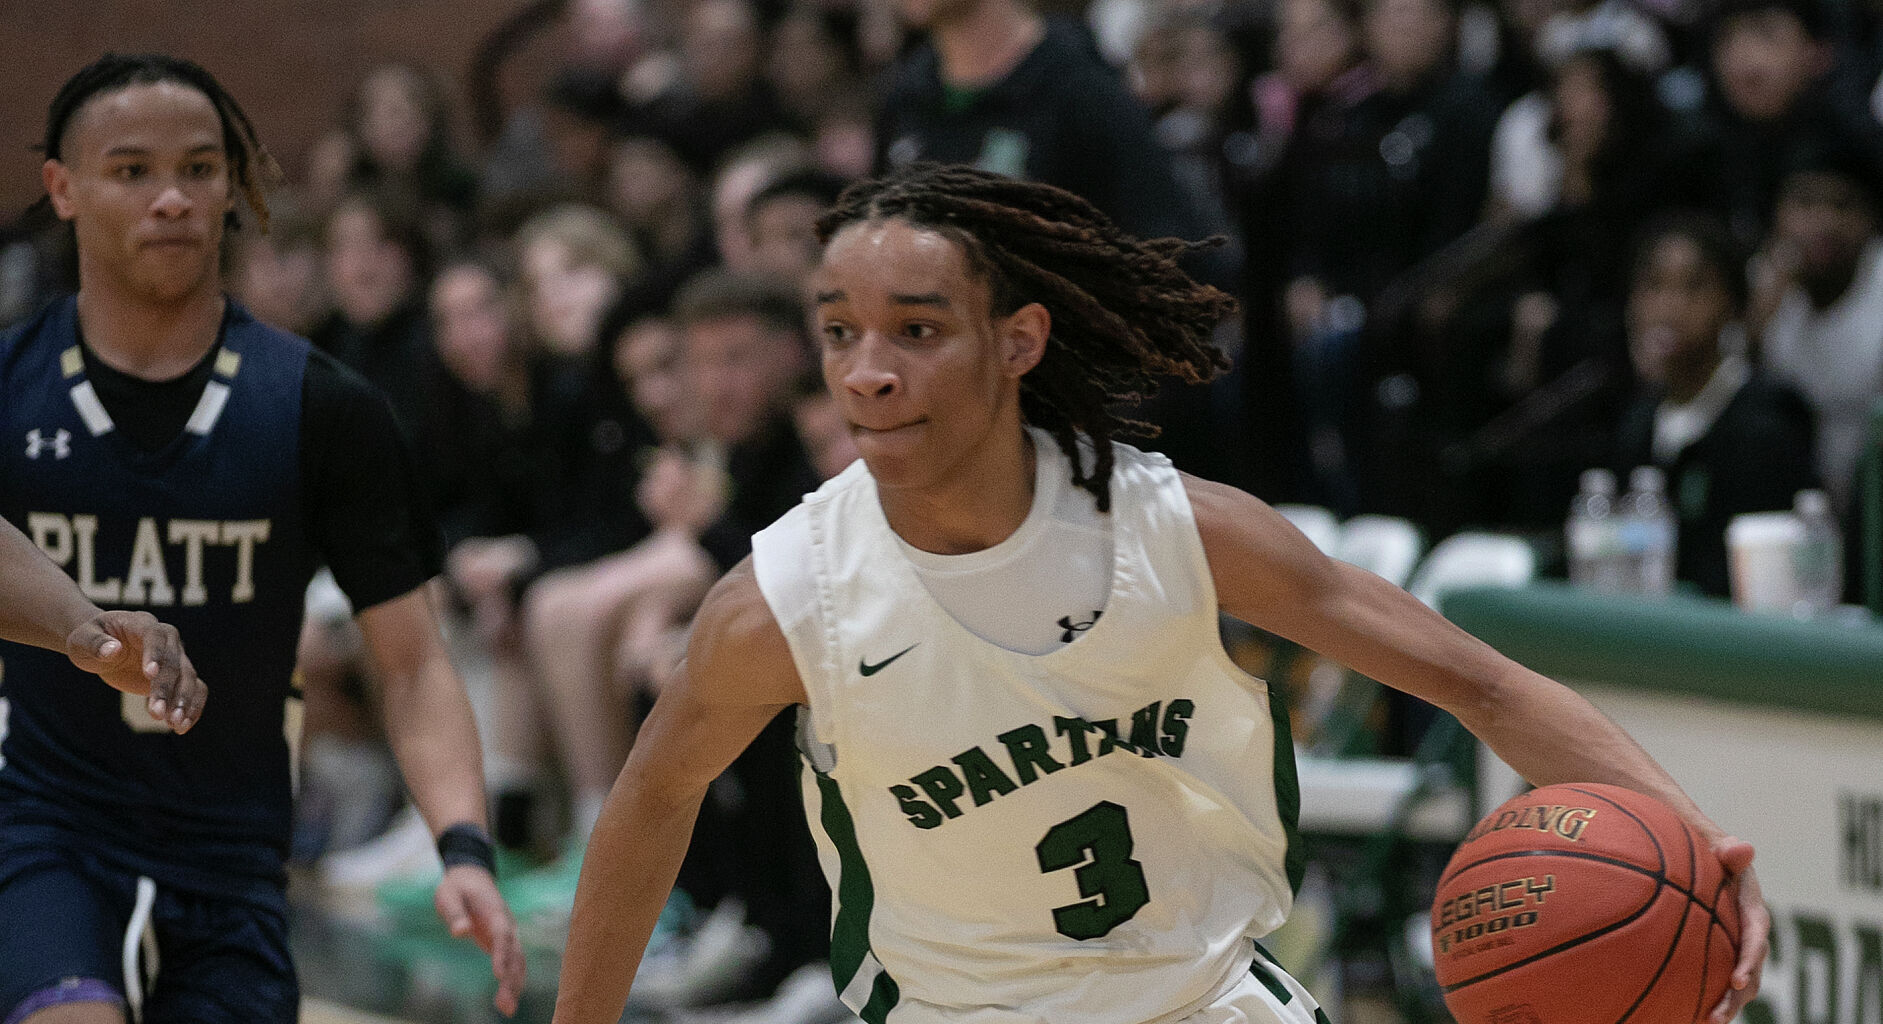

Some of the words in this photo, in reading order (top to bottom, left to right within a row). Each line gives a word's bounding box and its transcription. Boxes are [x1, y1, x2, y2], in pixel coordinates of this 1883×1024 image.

[27, 511, 271, 606] PLATT
[888, 698, 1195, 830] SPARTANS
[1035, 800, 1151, 941] 3
